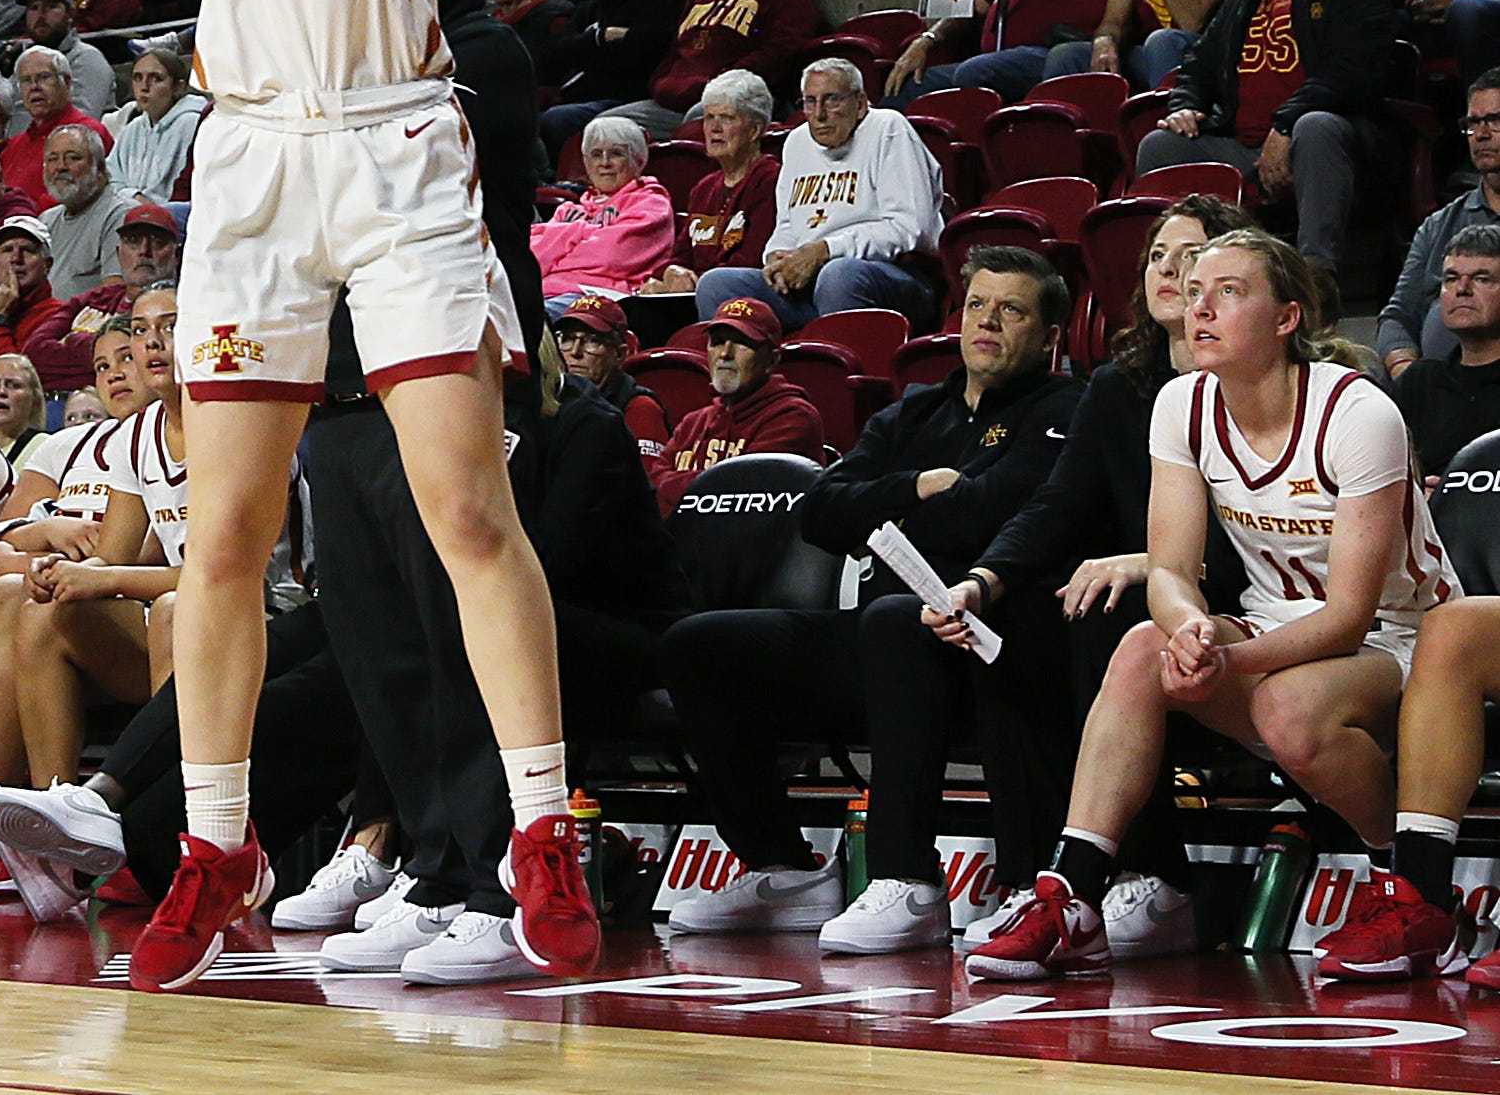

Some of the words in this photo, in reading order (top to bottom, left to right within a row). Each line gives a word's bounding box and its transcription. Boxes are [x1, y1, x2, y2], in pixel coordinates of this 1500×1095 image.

[1237, 14, 1299, 72] 55
[192, 337, 265, 365] STATE
[678, 492, 805, 514] POETRYY
[1260, 550, 1327, 601] 11
[504, 974, 1468, 1047] PIVO
